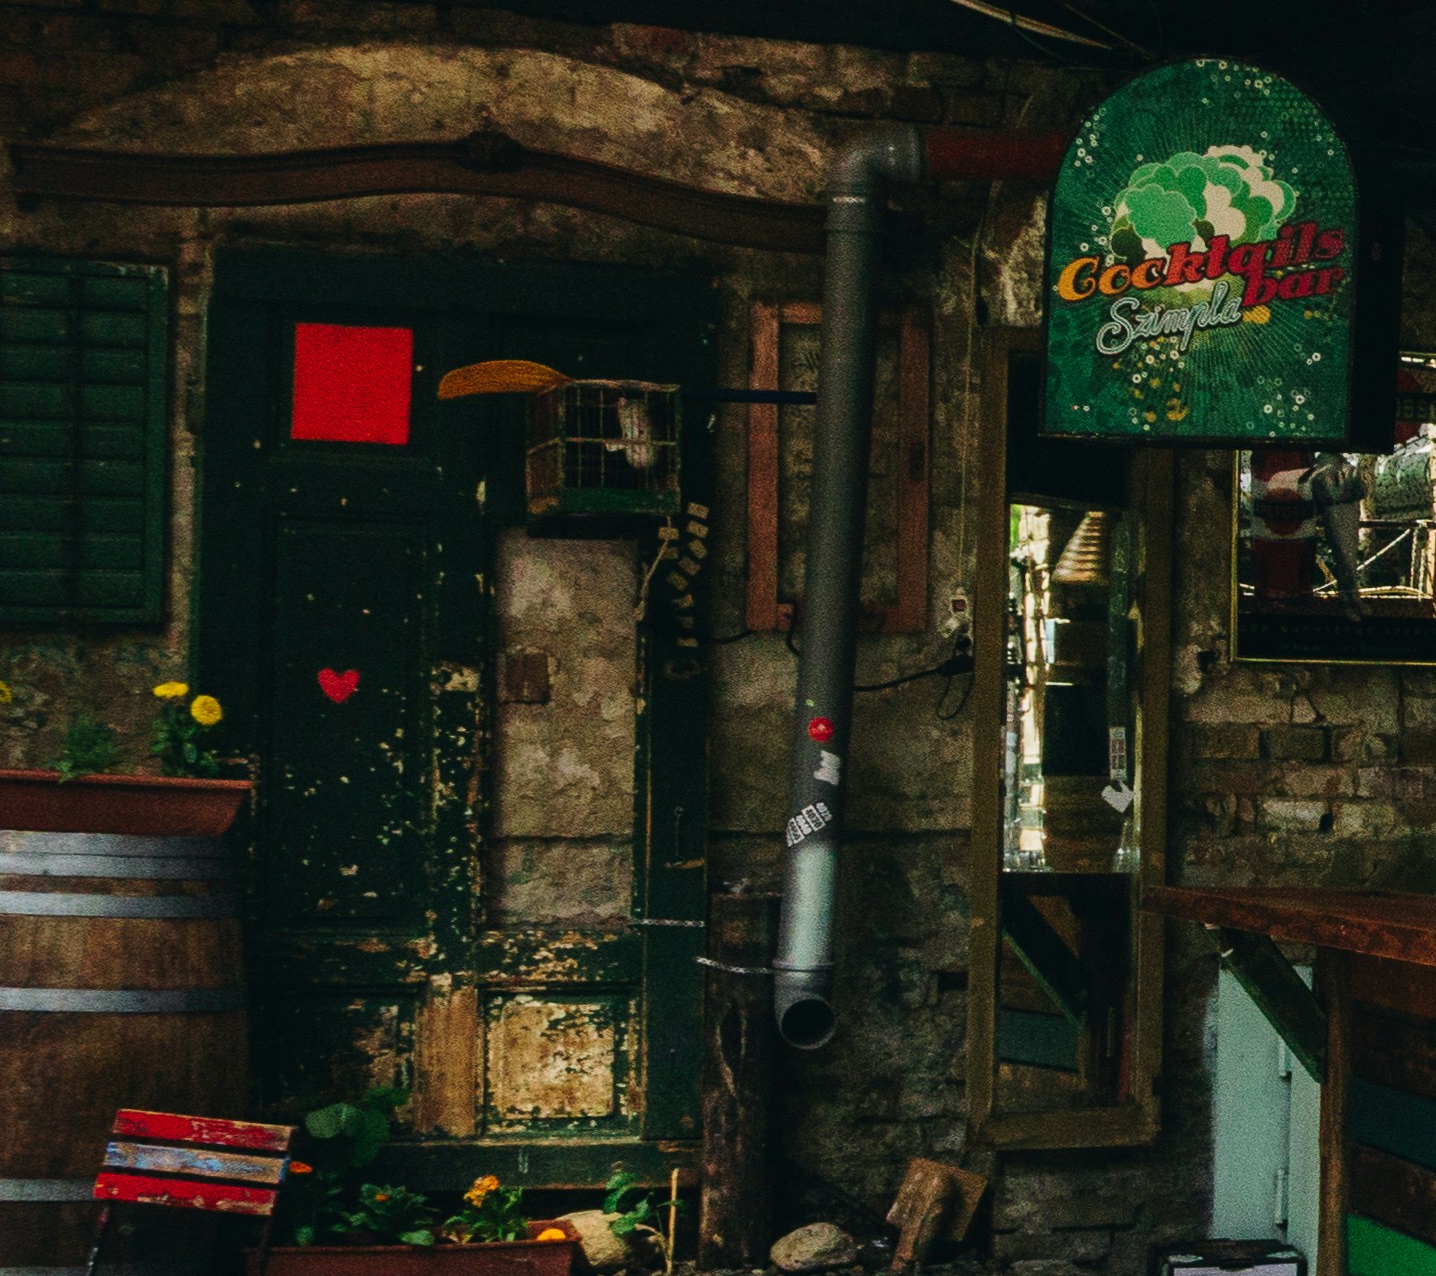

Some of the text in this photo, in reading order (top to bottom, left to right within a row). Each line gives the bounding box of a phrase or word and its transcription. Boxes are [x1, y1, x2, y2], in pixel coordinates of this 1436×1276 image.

[1056, 222, 1347, 304] Cocktails
[1242, 266, 1347, 308] bar
[1095, 281, 1243, 356] Szimpla
